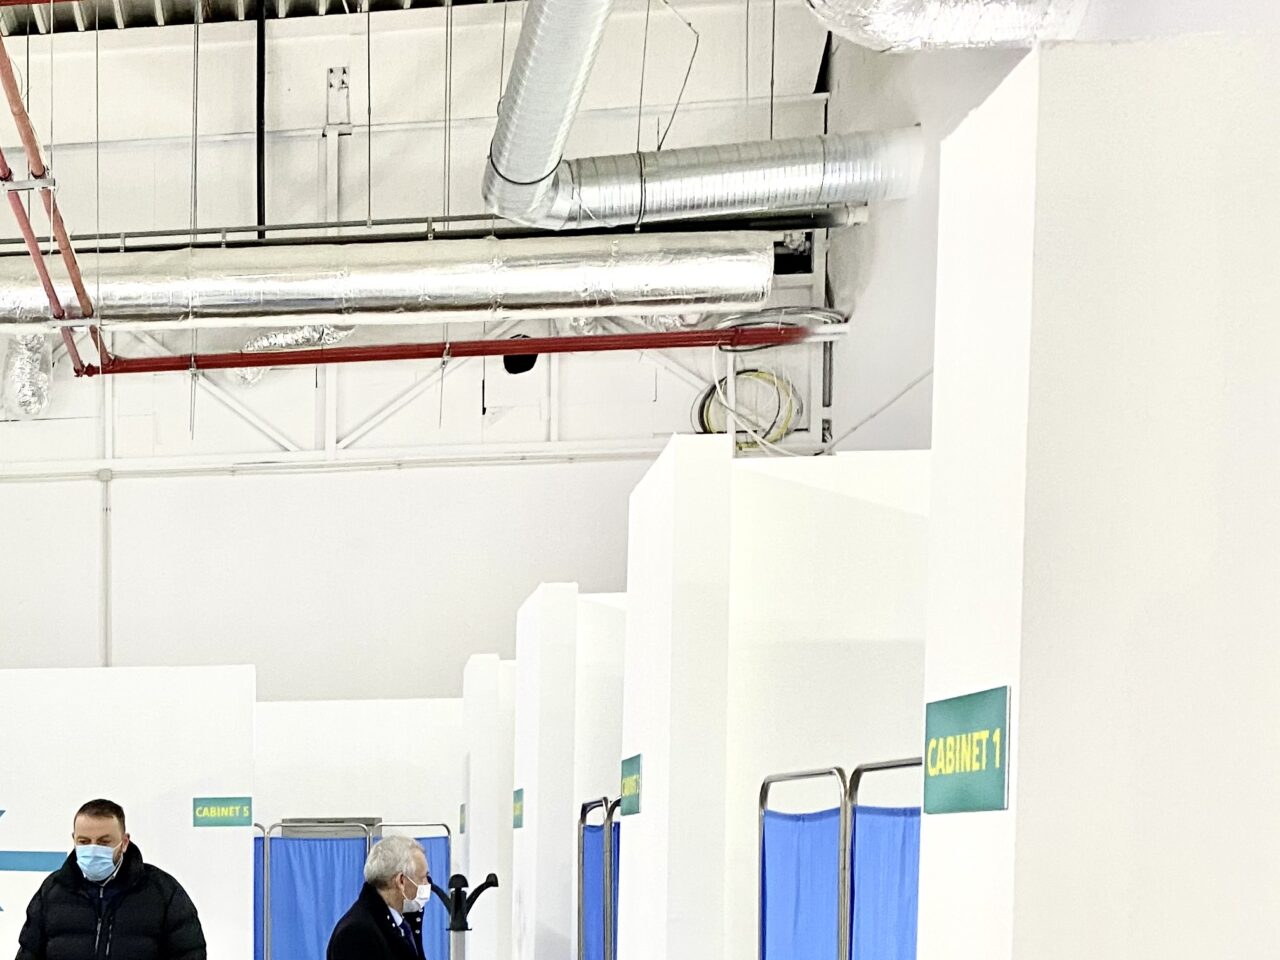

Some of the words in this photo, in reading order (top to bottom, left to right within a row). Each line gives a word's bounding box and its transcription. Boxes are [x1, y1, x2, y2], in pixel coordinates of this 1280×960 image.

[927, 729, 989, 776] CABINET
[992, 727, 1001, 769] 1
[195, 805, 241, 818] CABINET
[242, 805, 250, 817] 5
